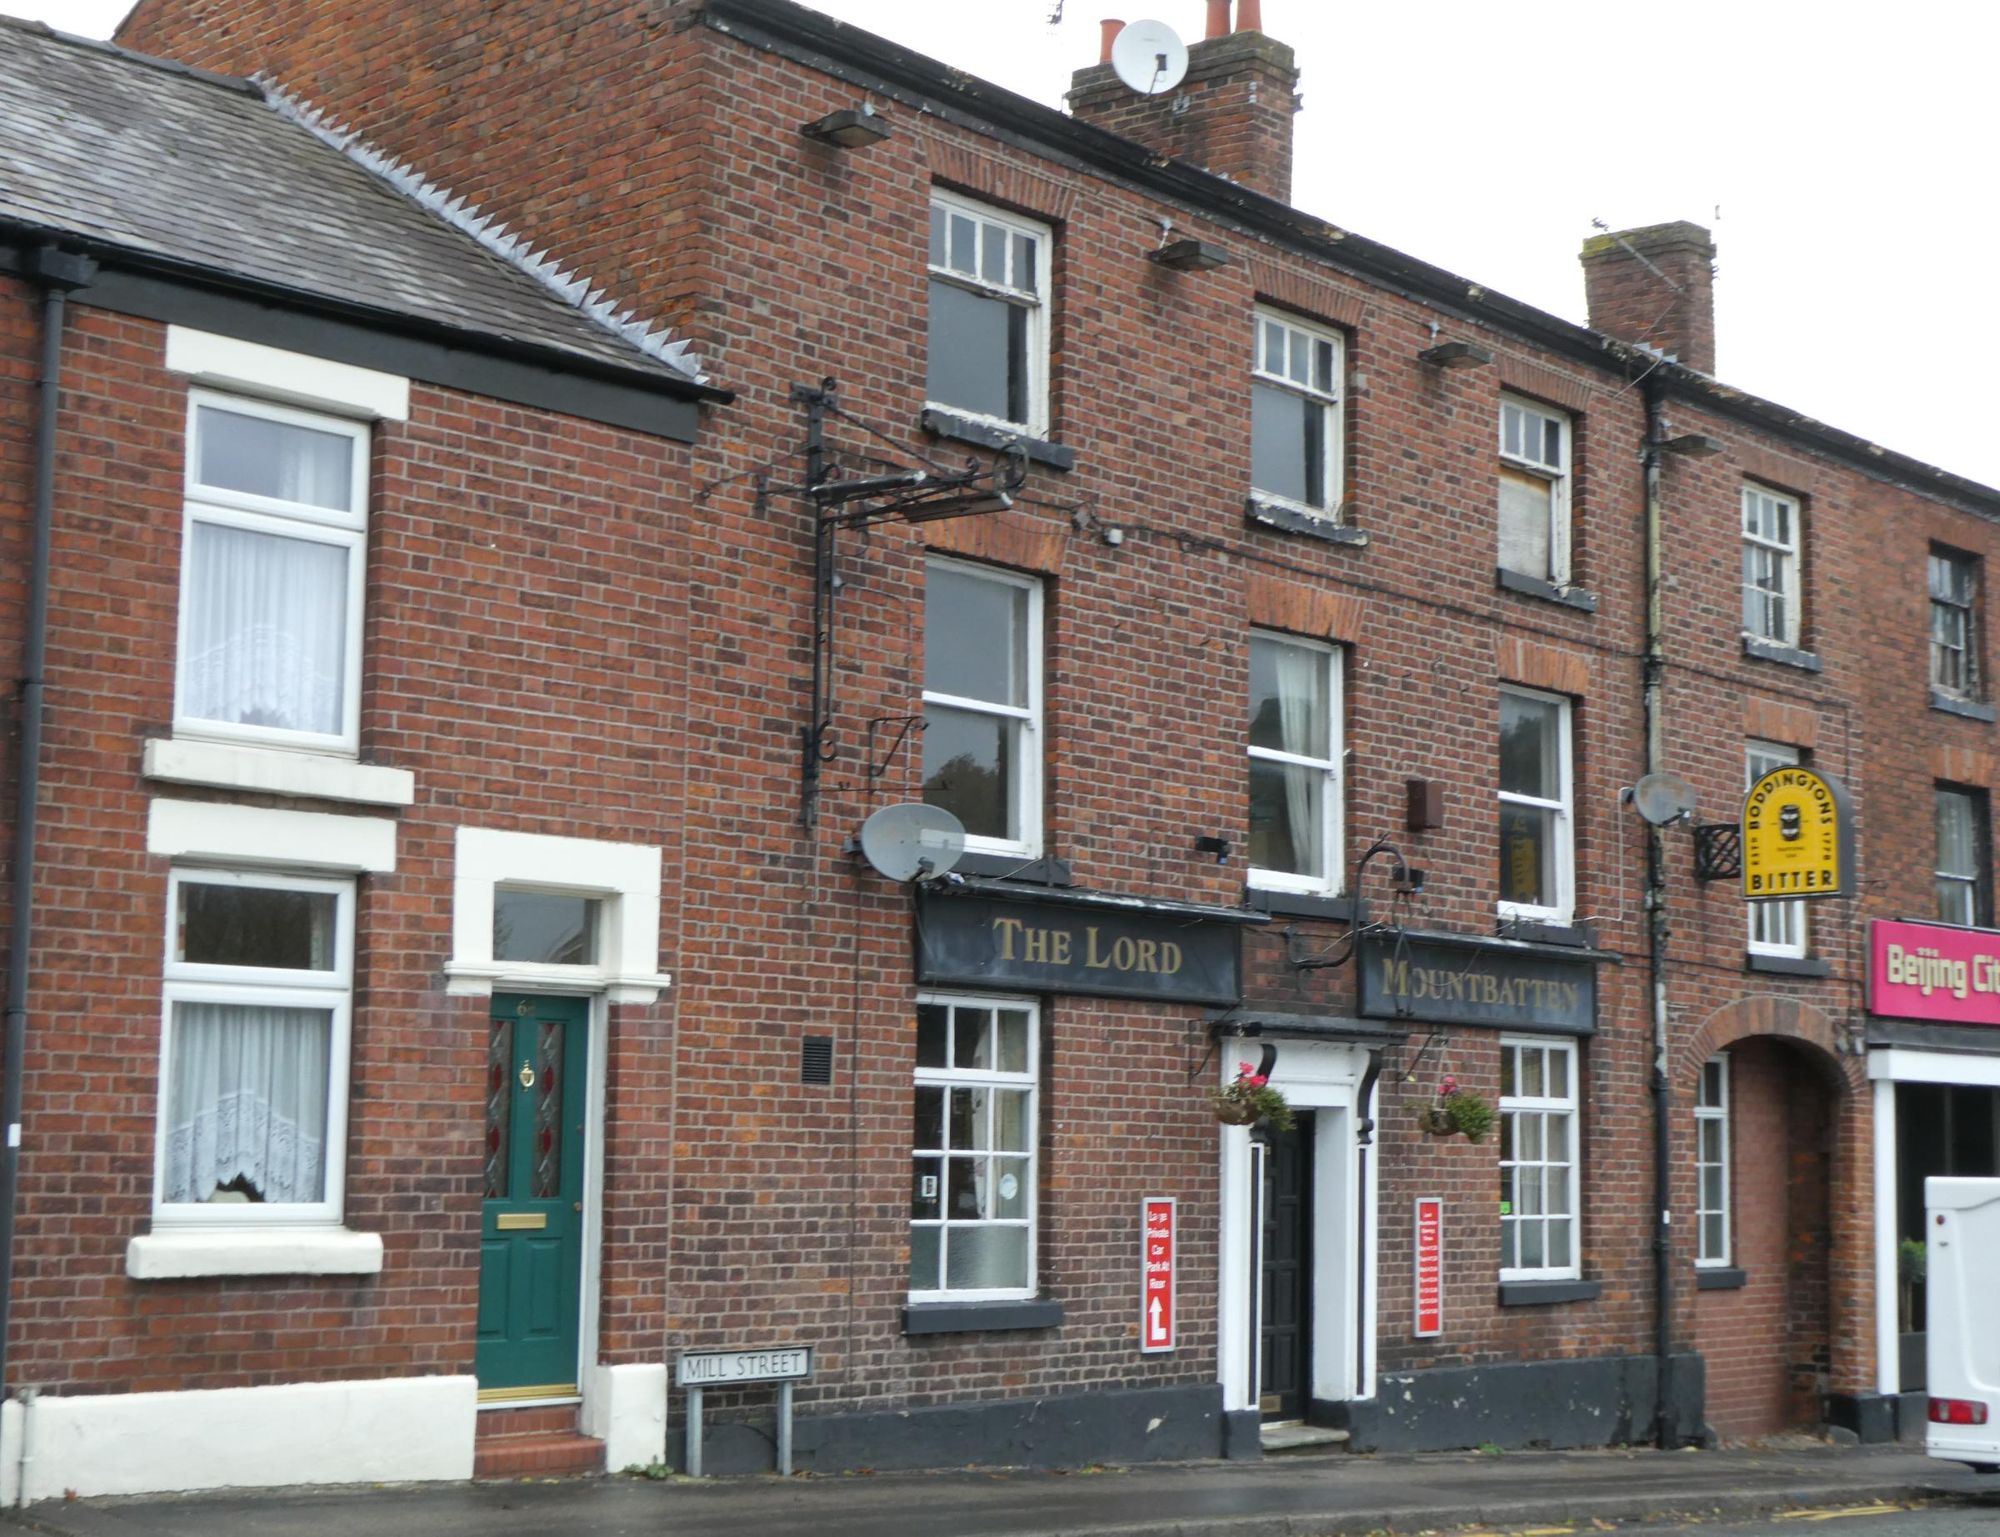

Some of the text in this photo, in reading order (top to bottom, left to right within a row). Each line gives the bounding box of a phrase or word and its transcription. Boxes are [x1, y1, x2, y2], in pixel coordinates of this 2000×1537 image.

[1748, 773, 1833, 830] BODDINGTONS
[1752, 870, 1832, 890] BITTER
[993, 917, 1183, 975] THE LORD
[1887, 944, 1968, 999] Beijing
[1381, 958, 1579, 1011] MOUNTBATTEN
[686, 1353, 801, 1379] MILL STREET
